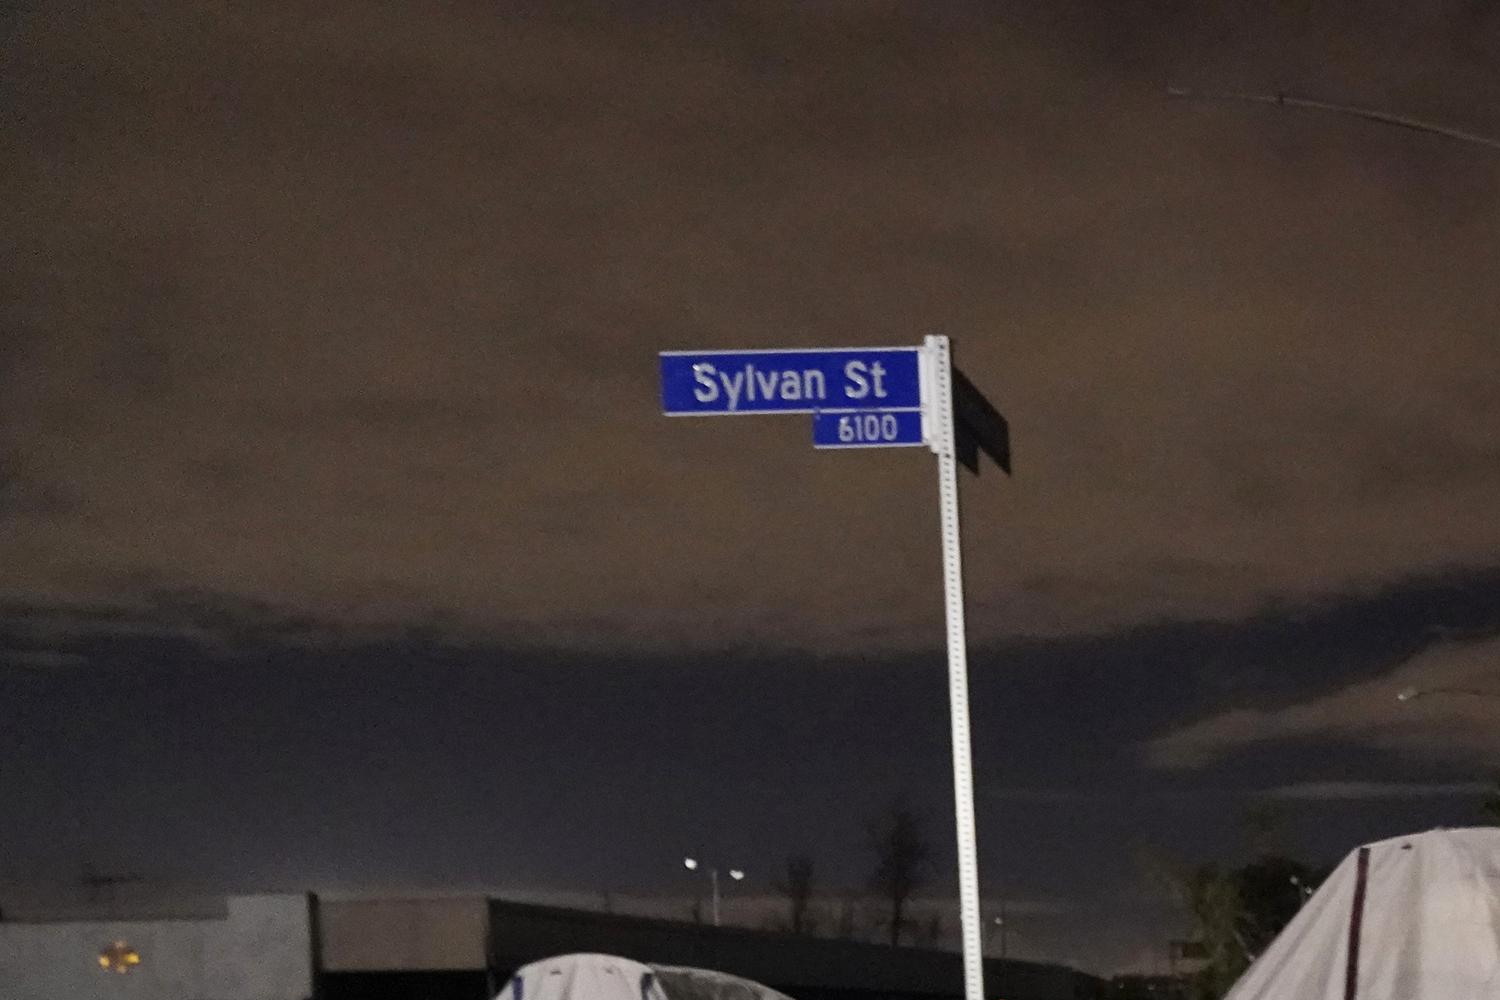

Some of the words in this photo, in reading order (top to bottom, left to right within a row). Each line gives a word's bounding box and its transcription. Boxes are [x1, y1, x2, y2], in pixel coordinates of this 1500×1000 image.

[693, 363, 825, 411] Sylvan
[844, 360, 887, 399] St
[839, 414, 897, 442] 6100
